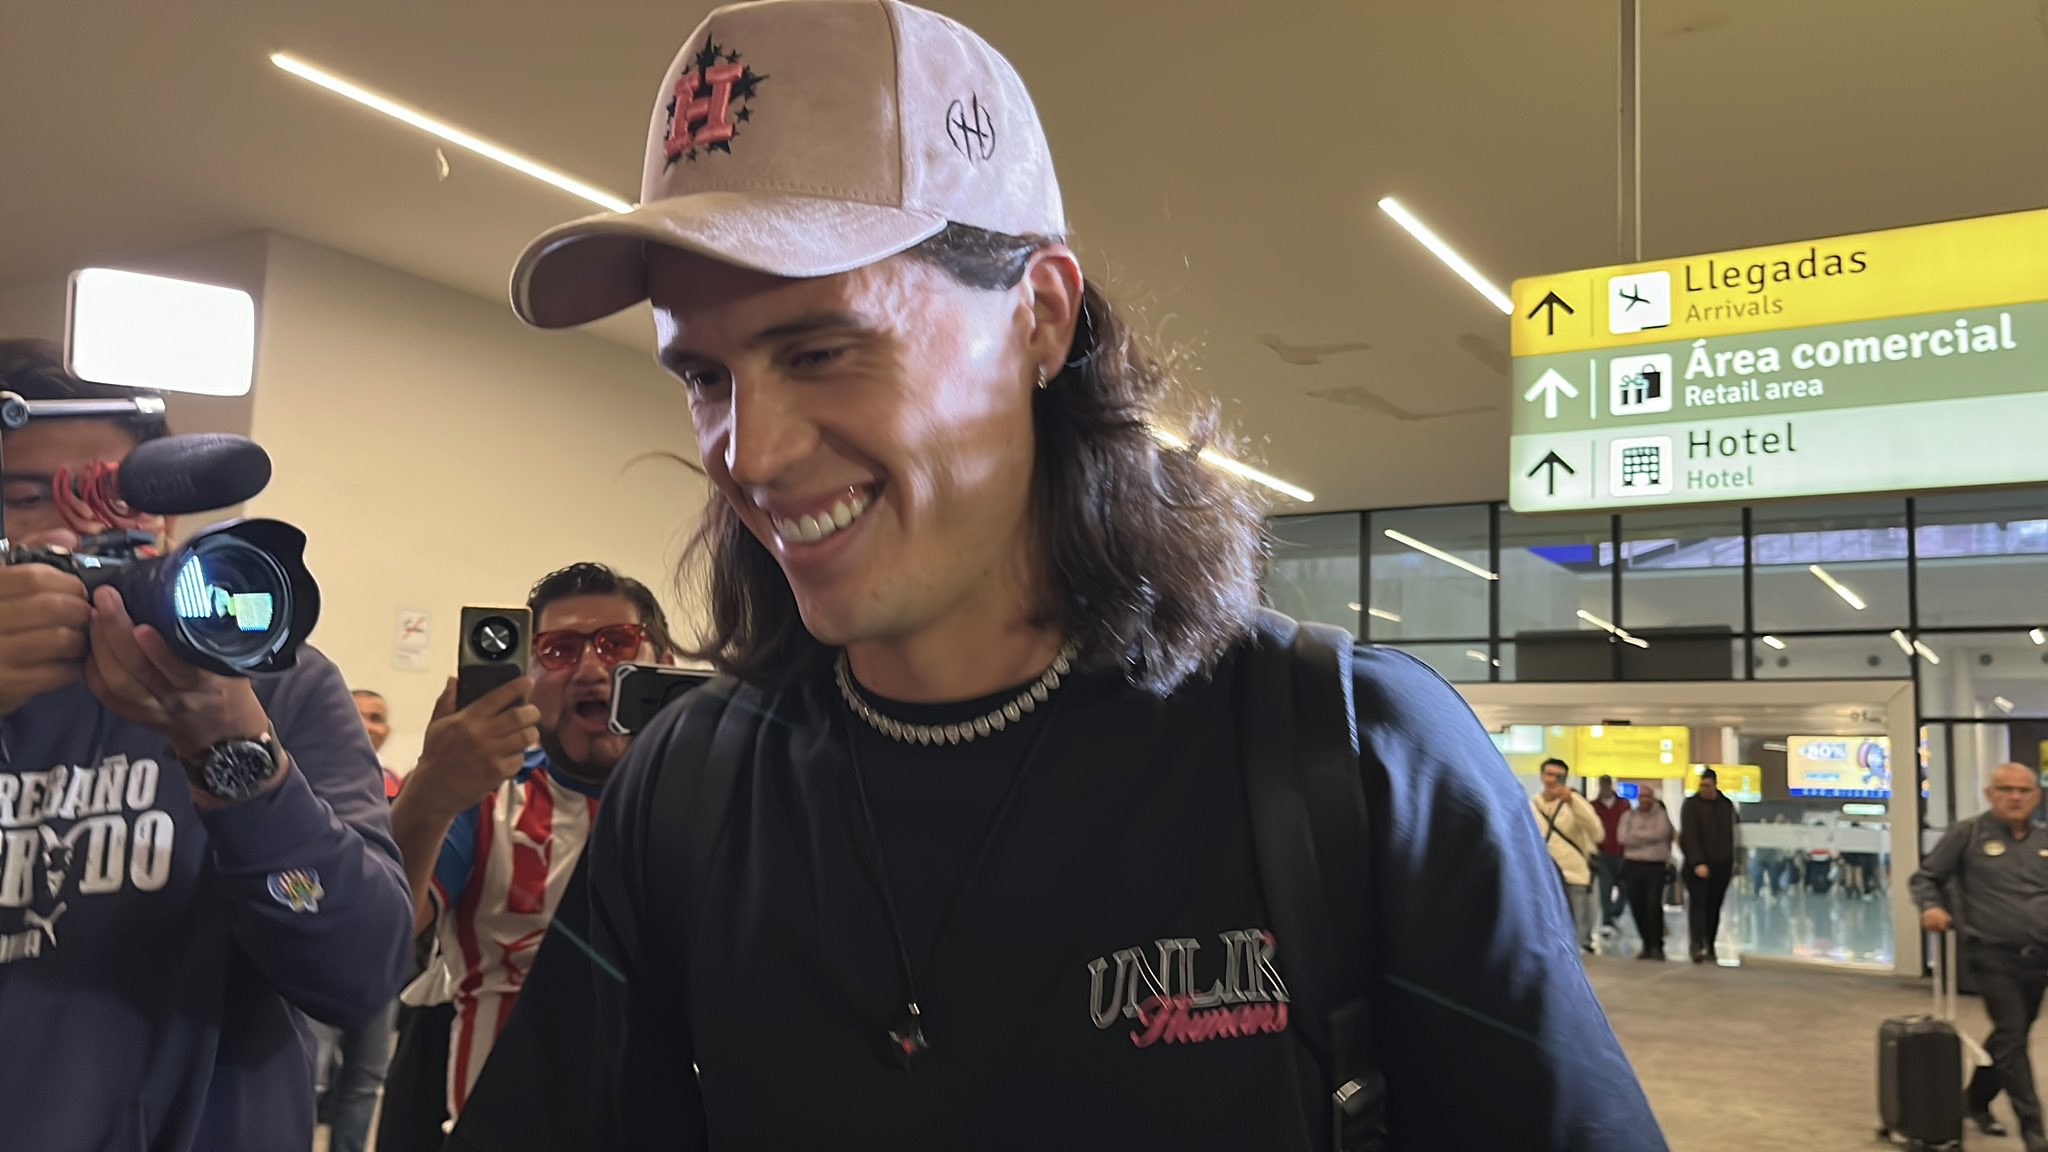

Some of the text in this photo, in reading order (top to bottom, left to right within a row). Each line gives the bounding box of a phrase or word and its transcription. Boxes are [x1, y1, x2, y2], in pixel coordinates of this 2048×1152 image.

[1685, 247, 1868, 296] Llegadas
[1685, 295, 1784, 323] Arrivals
[1684, 312, 2018, 381] Área comercial
[1684, 376, 1825, 407] Retail area
[1688, 423, 1798, 459] Hotel
[1687, 466, 1754, 490] Hotel
